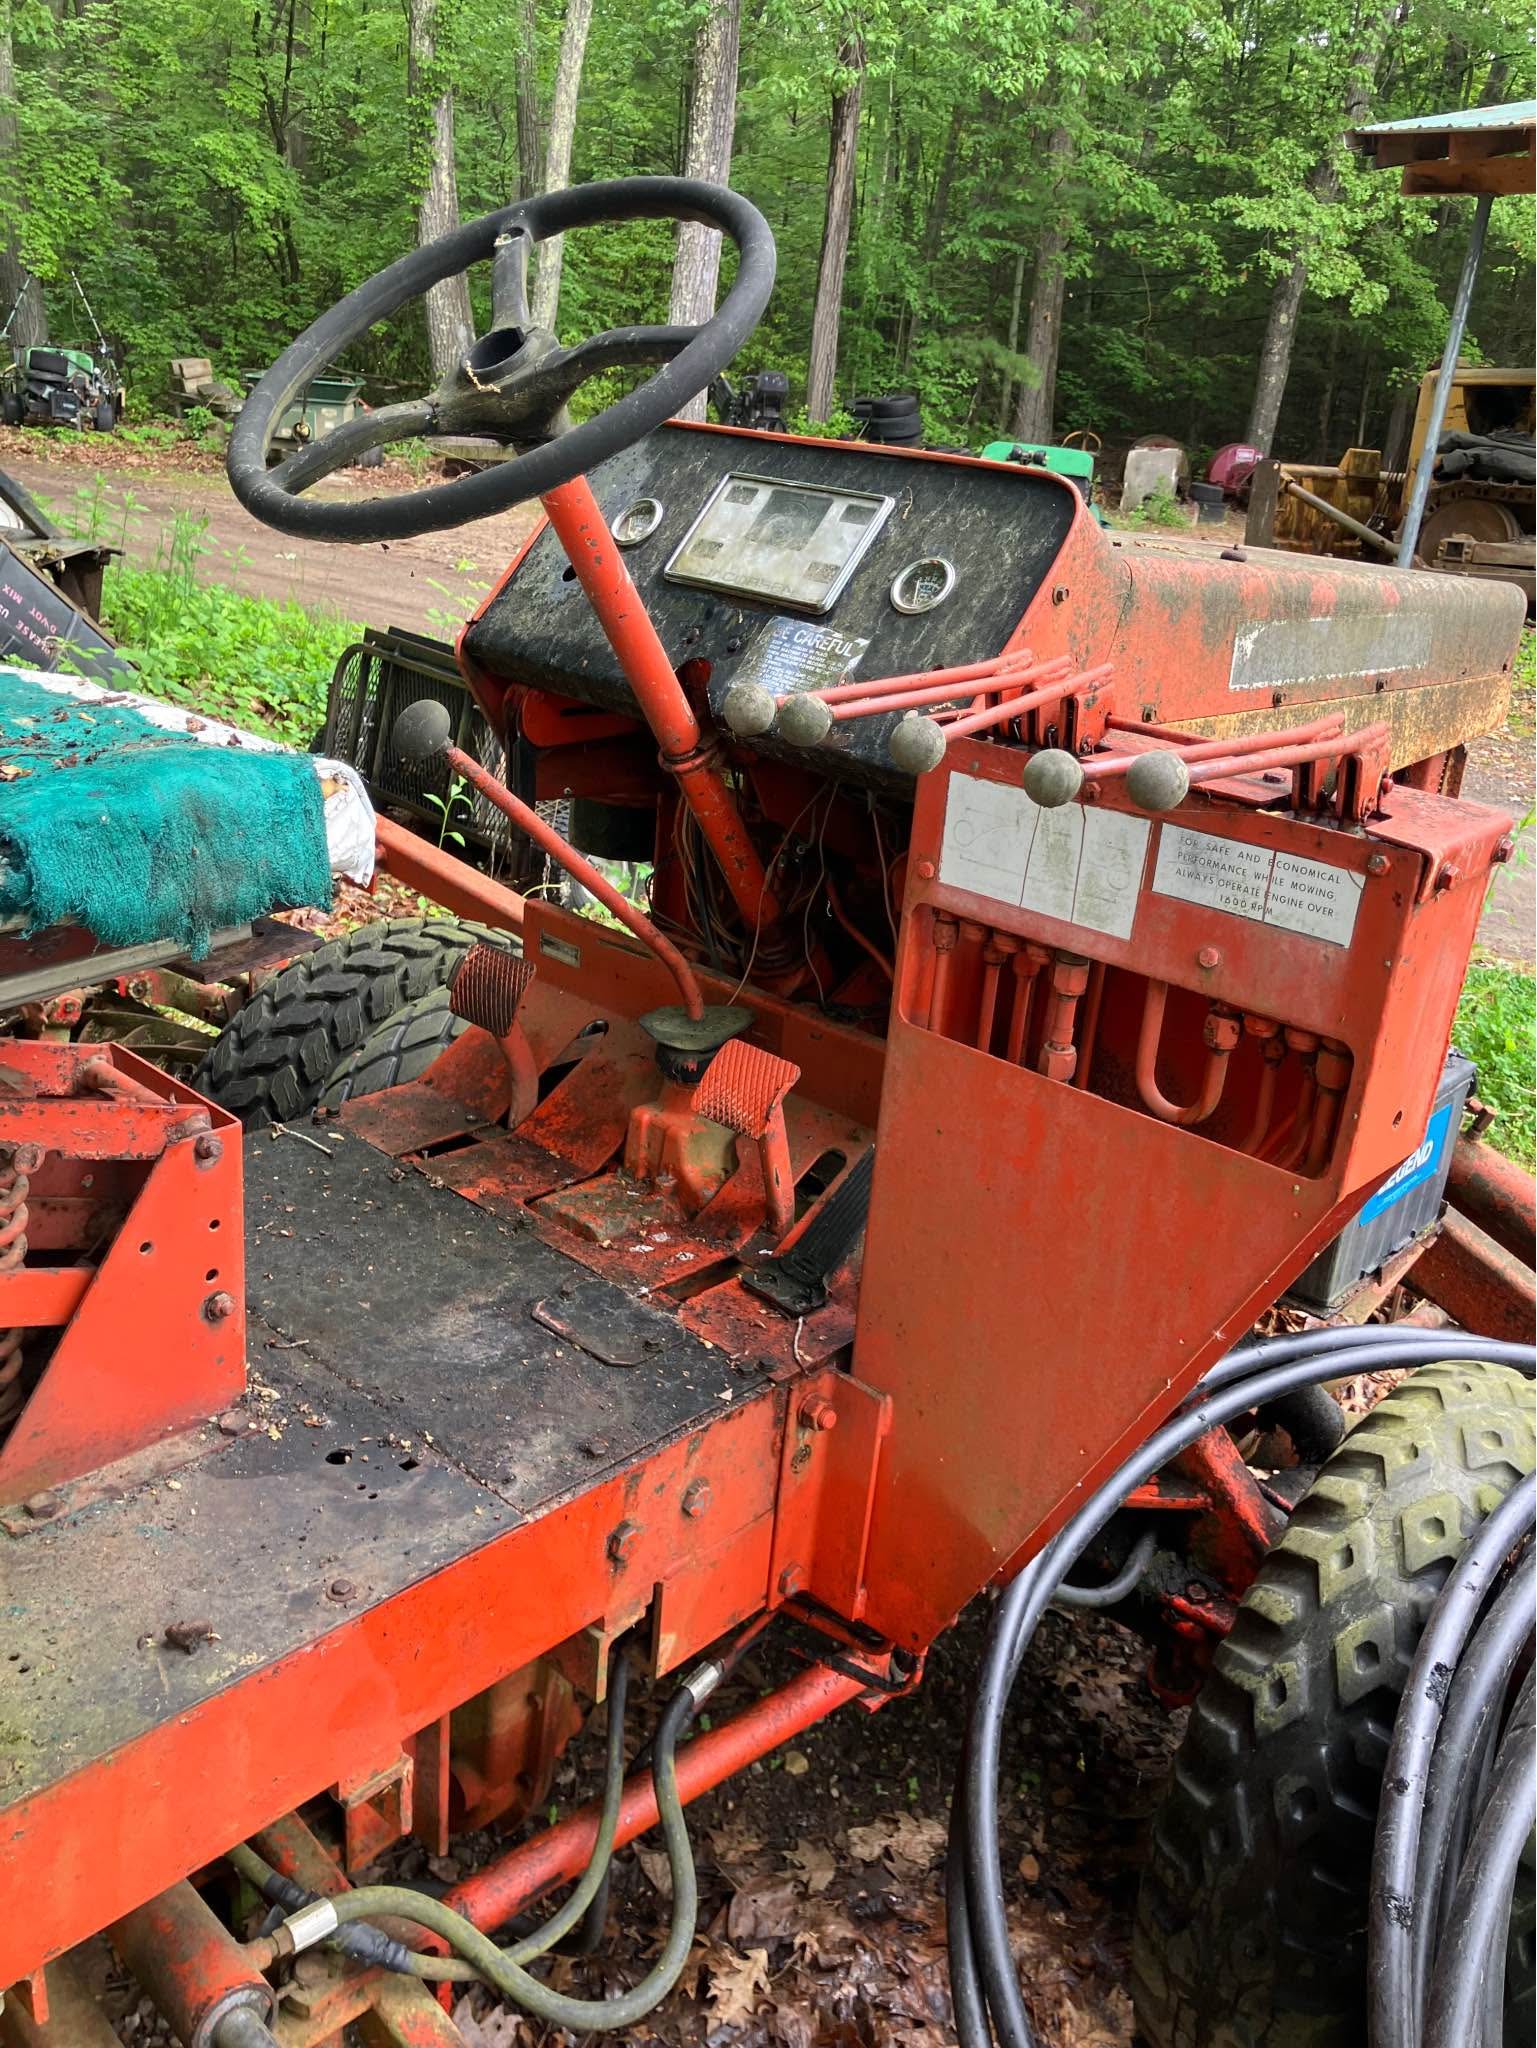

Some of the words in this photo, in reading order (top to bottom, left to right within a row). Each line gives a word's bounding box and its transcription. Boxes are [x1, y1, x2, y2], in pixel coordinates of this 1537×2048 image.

[2, 583, 23, 604] MIX
[773, 624, 794, 640] BE
[794, 629, 853, 657] CAREFUL
[1177, 851, 1247, 877] PERFORMANCE
[1254, 871, 1285, 887] WHILE
[1180, 835, 1199, 848] FOR
[1206, 842, 1231, 856] SAFE
[1237, 851, 1261, 863] AND
[1268, 859, 1341, 884] ECONOMICAL
[1175, 868, 1214, 885] ALWAYS
[1218, 879, 1260, 897] OPERATE
[1264, 891, 1305, 910] ENGINE
[1307, 903, 1334, 918] OVER
[1220, 893, 1247, 909] 1600
[1251, 902, 1273, 916] RPM
[1377, 1140, 1434, 1196] EGEND
